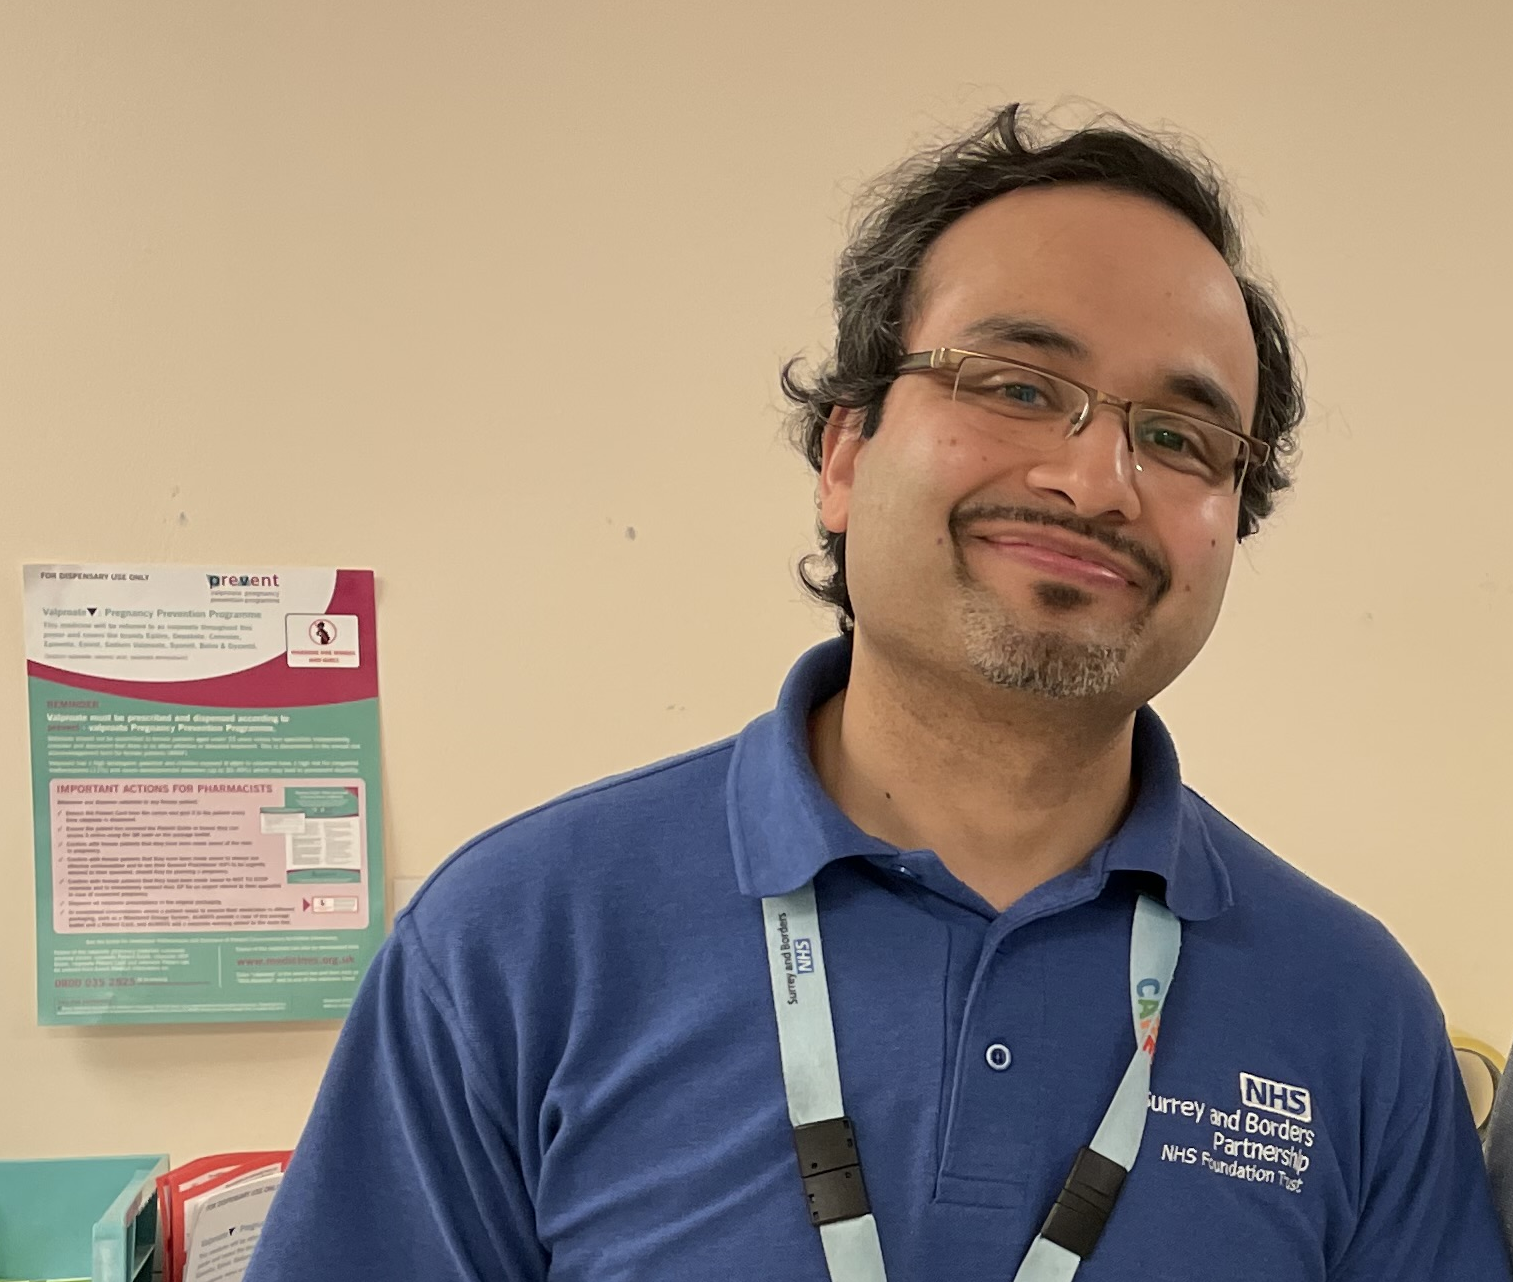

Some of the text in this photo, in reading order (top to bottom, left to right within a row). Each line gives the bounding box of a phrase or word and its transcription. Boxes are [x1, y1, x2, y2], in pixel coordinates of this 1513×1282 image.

[208, 573, 280, 588] prevent
[56, 783, 273, 795] IMPORTANT ACTIONS FOR PHARMACISTS
[776, 912, 798, 1005] Surrey and Borders
[795, 940, 813, 973] NHS
[1243, 1076, 1308, 1118] NHS
[1209, 1107, 1242, 1132] and
[1245, 1112, 1315, 1148] Borders
[1161, 1144, 1304, 1194] NHS Foundation Trust
[1213, 1131, 1310, 1175] Partnership
